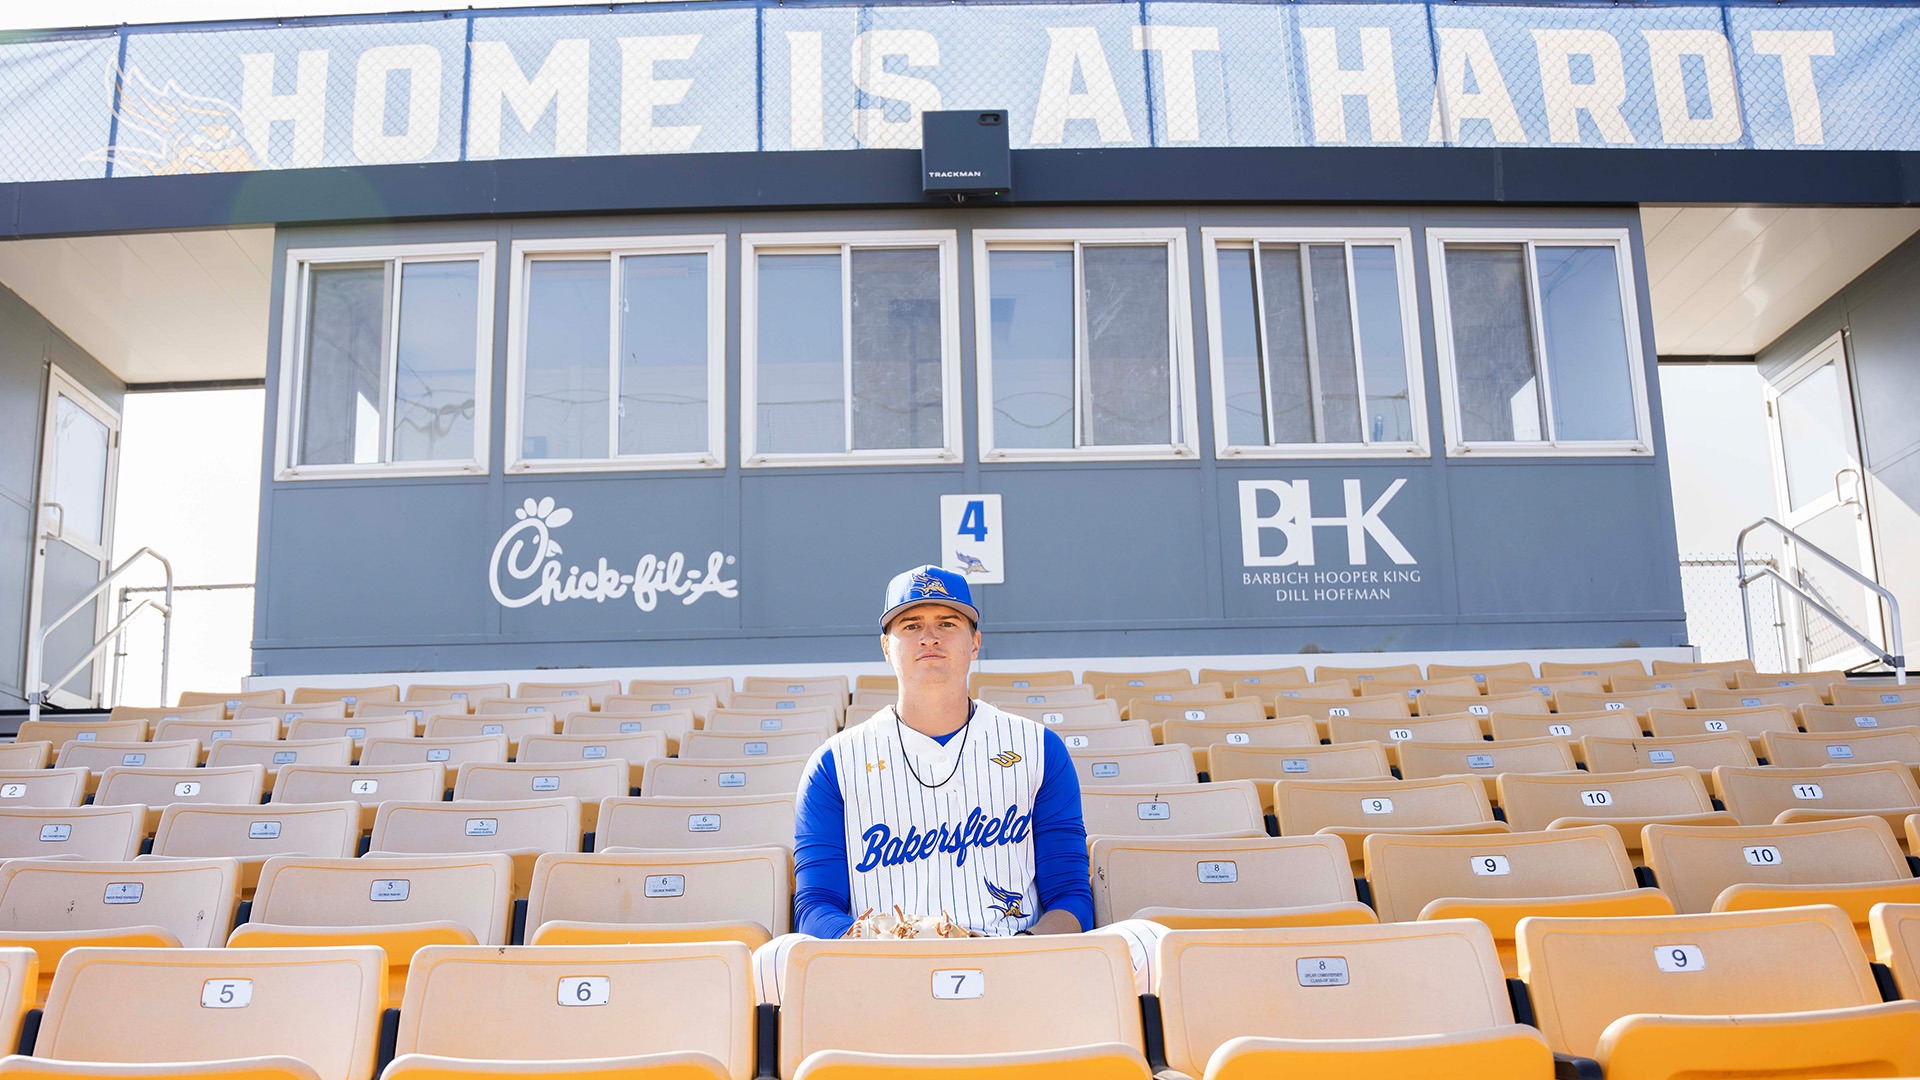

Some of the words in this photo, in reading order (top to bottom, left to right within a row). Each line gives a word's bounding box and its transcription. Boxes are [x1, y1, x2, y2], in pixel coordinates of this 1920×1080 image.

[240, 34, 703, 167] HOME
[785, 28, 942, 151] IS
[1031, 24, 1220, 145] AT
[1300, 26, 1834, 147] HARDT
[957, 501, 988, 542] 4
[1238, 478, 1417, 567] BHK
[1242, 571, 1309, 585] BARBICH
[1314, 571, 1378, 584] HOOPER
[1383, 570, 1421, 583] KING
[1276, 589, 1309, 602] DILL
[1314, 588, 1390, 601] HOFFMAN
[1554, 726, 1566, 734] 11
[1710, 721, 1723, 730] 12
[1234, 734, 1241, 743] 9
[1395, 730, 1408, 739] 10
[1073, 737, 1080, 746] 8
[9, 786, 18, 796] 2
[183, 784, 191, 795] 3
[360, 782, 368, 792] 4
[1799, 786, 1815, 797] 11
[1587, 792, 1606, 804] 10
[1372, 800, 1383, 812] 9
[856, 804, 1032, 873] Bakersfield
[1751, 848, 1774, 863] 10
[1484, 858, 1497, 872] 9
[388, 882, 394, 890] 5
[1672, 949, 1687, 968] 9
[1319, 960, 1326, 970] 8
[951, 975, 966, 994] 7
[219, 984, 235, 1003] 5
[577, 982, 591, 1001] 6
